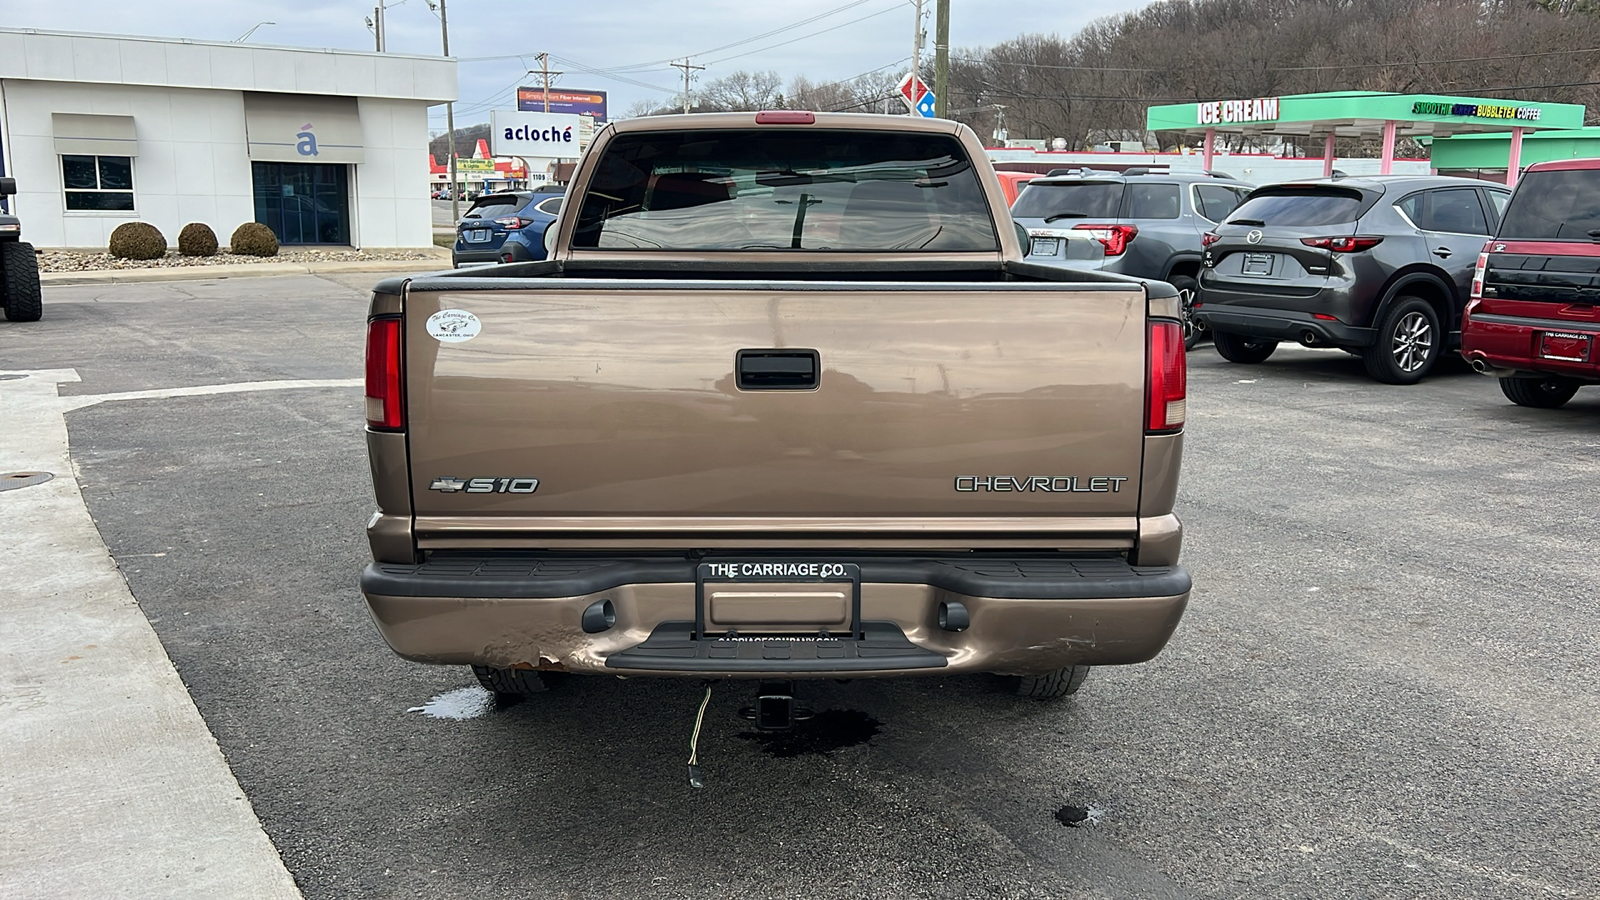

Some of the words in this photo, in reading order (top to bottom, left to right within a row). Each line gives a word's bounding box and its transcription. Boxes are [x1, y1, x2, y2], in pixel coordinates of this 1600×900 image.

[1197, 101, 1222, 124] ICE
[1223, 98, 1279, 122] CREAM
[1477, 105, 1516, 118] BUBBLETEA
[1517, 108, 1541, 120] COFFEE
[296, 122, 319, 157] á
[504, 125, 572, 142] acloché
[1555, 332, 1579, 340] CARRIAGE
[466, 478, 539, 493] S10
[956, 476, 1128, 492] CHEVROLET
[709, 563, 738, 576] THE
[742, 563, 818, 576] CARRIAGE
[822, 563, 848, 576] CO.
